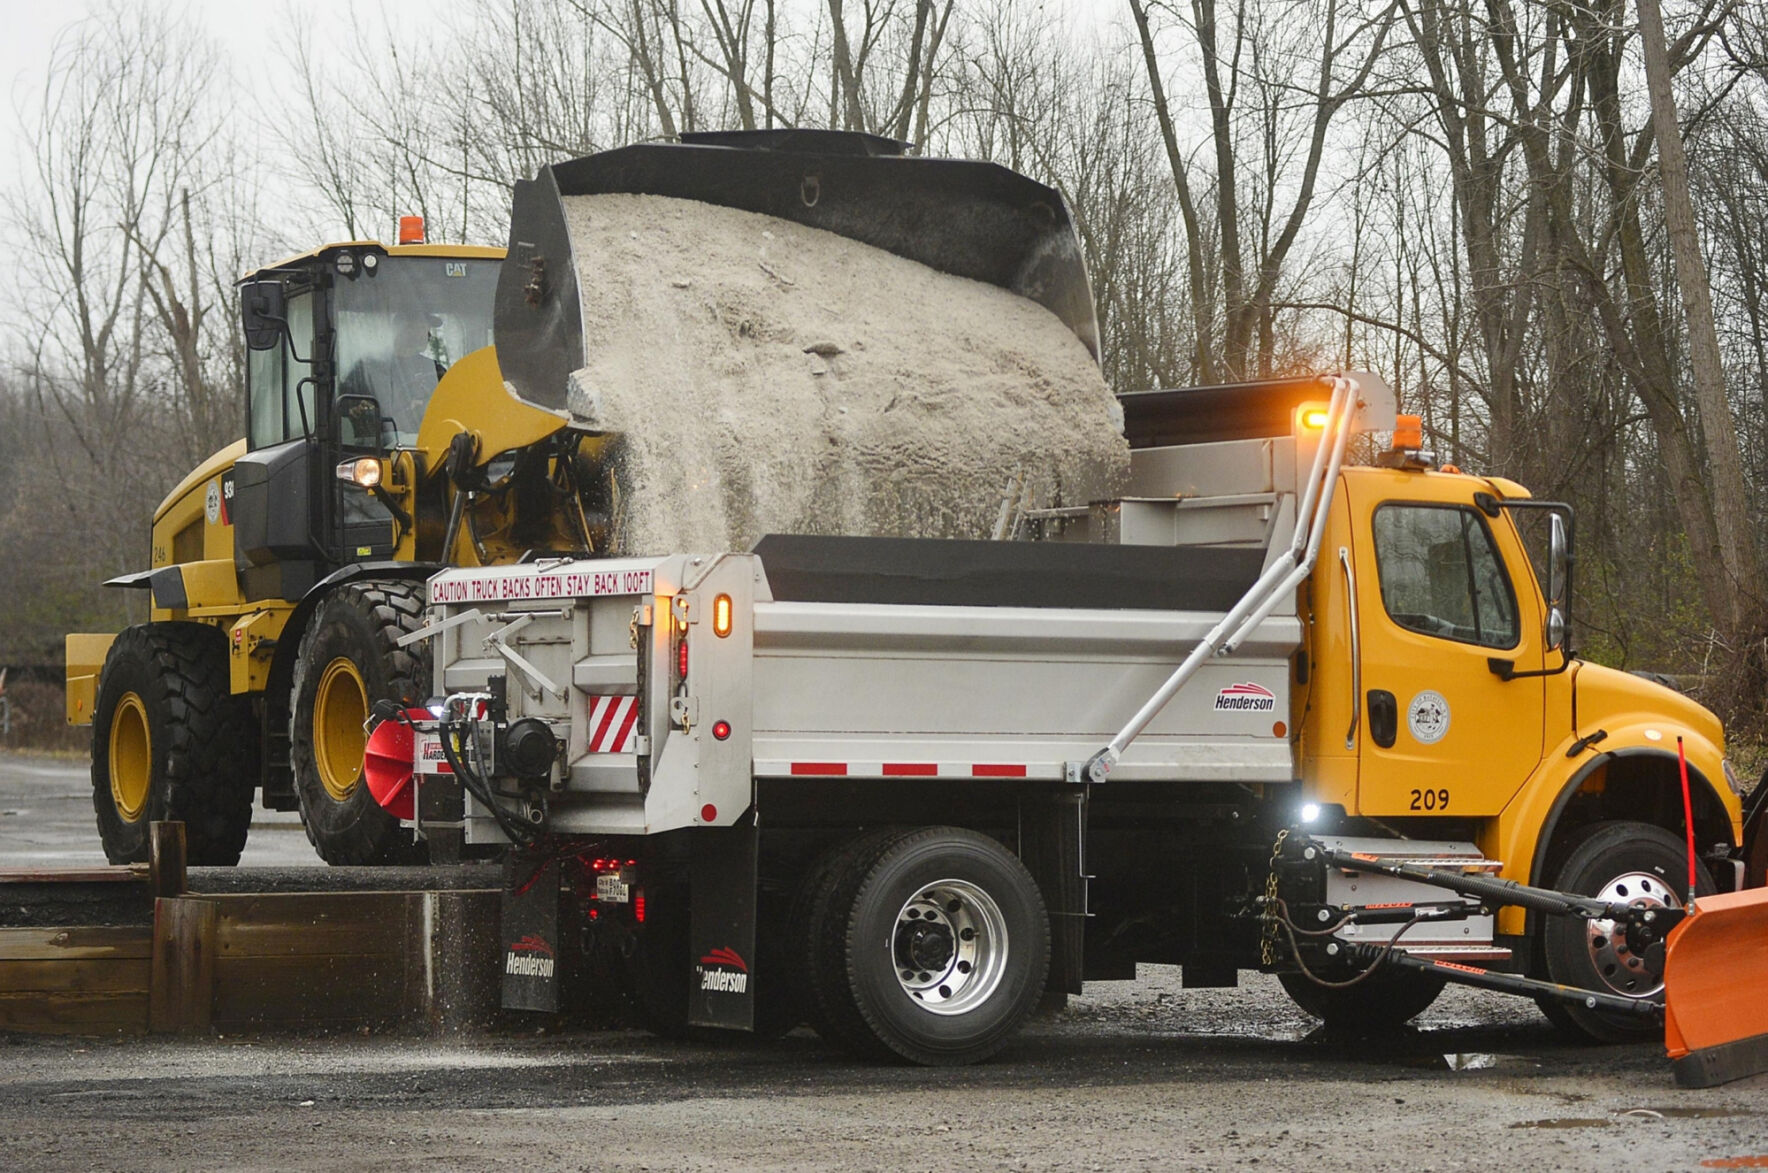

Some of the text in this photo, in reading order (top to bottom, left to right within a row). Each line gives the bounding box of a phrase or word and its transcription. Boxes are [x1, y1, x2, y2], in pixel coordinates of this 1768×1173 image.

[446, 263, 467, 277] CAT
[154, 545, 167, 564] 246
[433, 571, 650, 601] CAUTION TRUCK BACKS OFTEN STAY BACK 100FT
[1215, 695, 1274, 711] Henderson
[1410, 788, 1450, 811] 209
[506, 951, 554, 978] Henderson
